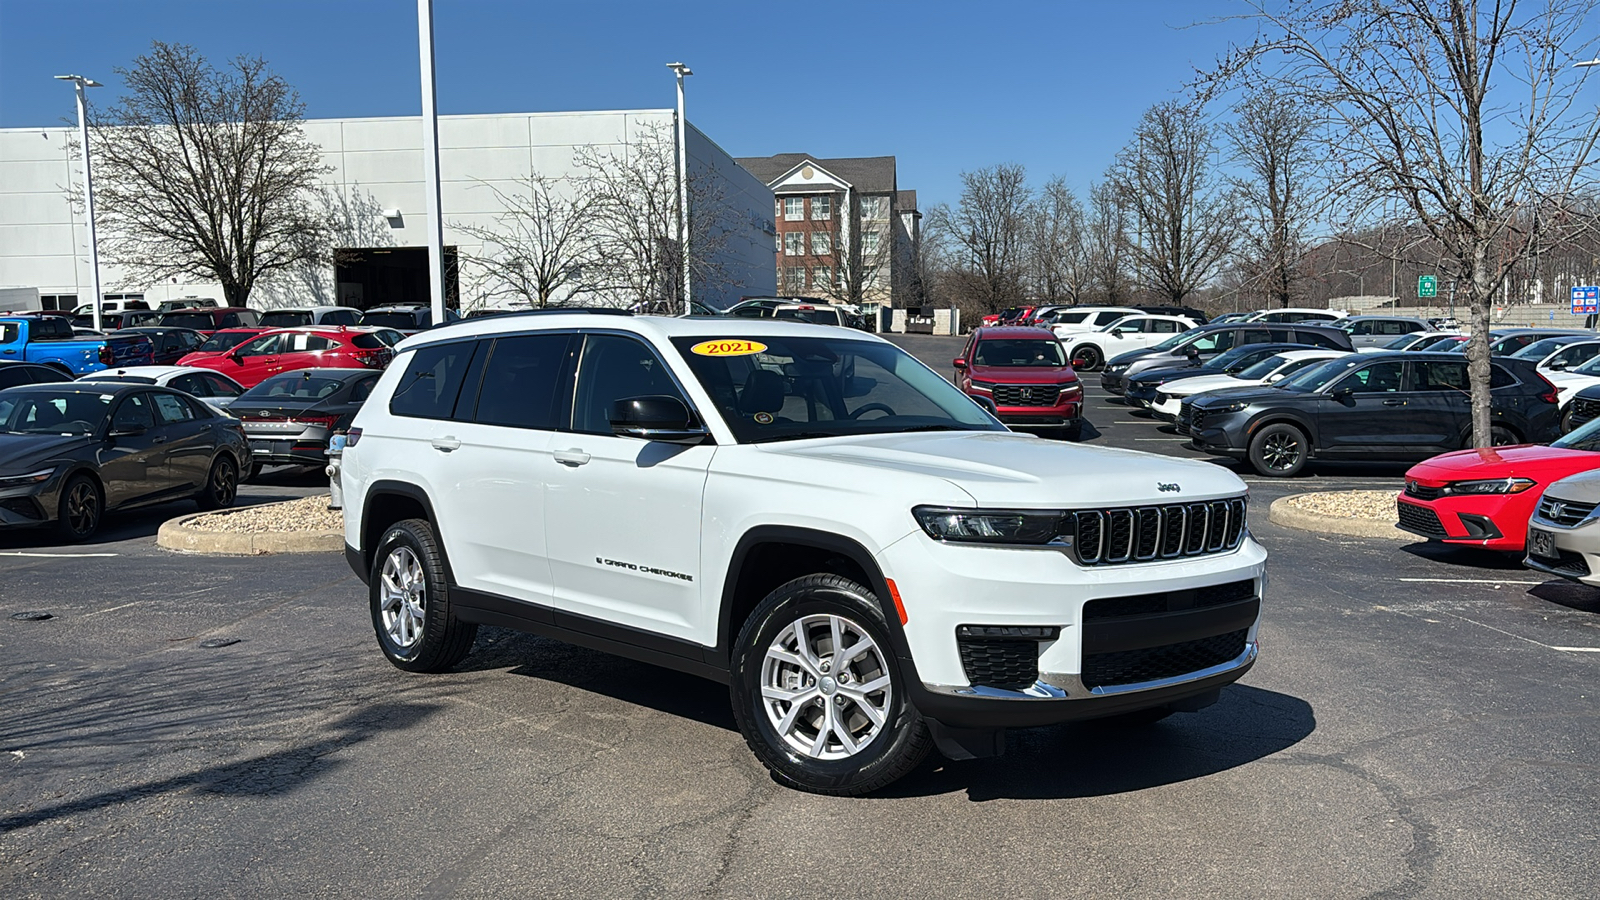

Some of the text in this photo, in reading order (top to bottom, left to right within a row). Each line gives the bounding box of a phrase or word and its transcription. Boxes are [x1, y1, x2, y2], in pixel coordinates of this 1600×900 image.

[707, 342, 754, 354] 2021
[1157, 481, 1181, 493] Jeep
[604, 559, 693, 582] GRAND CHEROKEE
